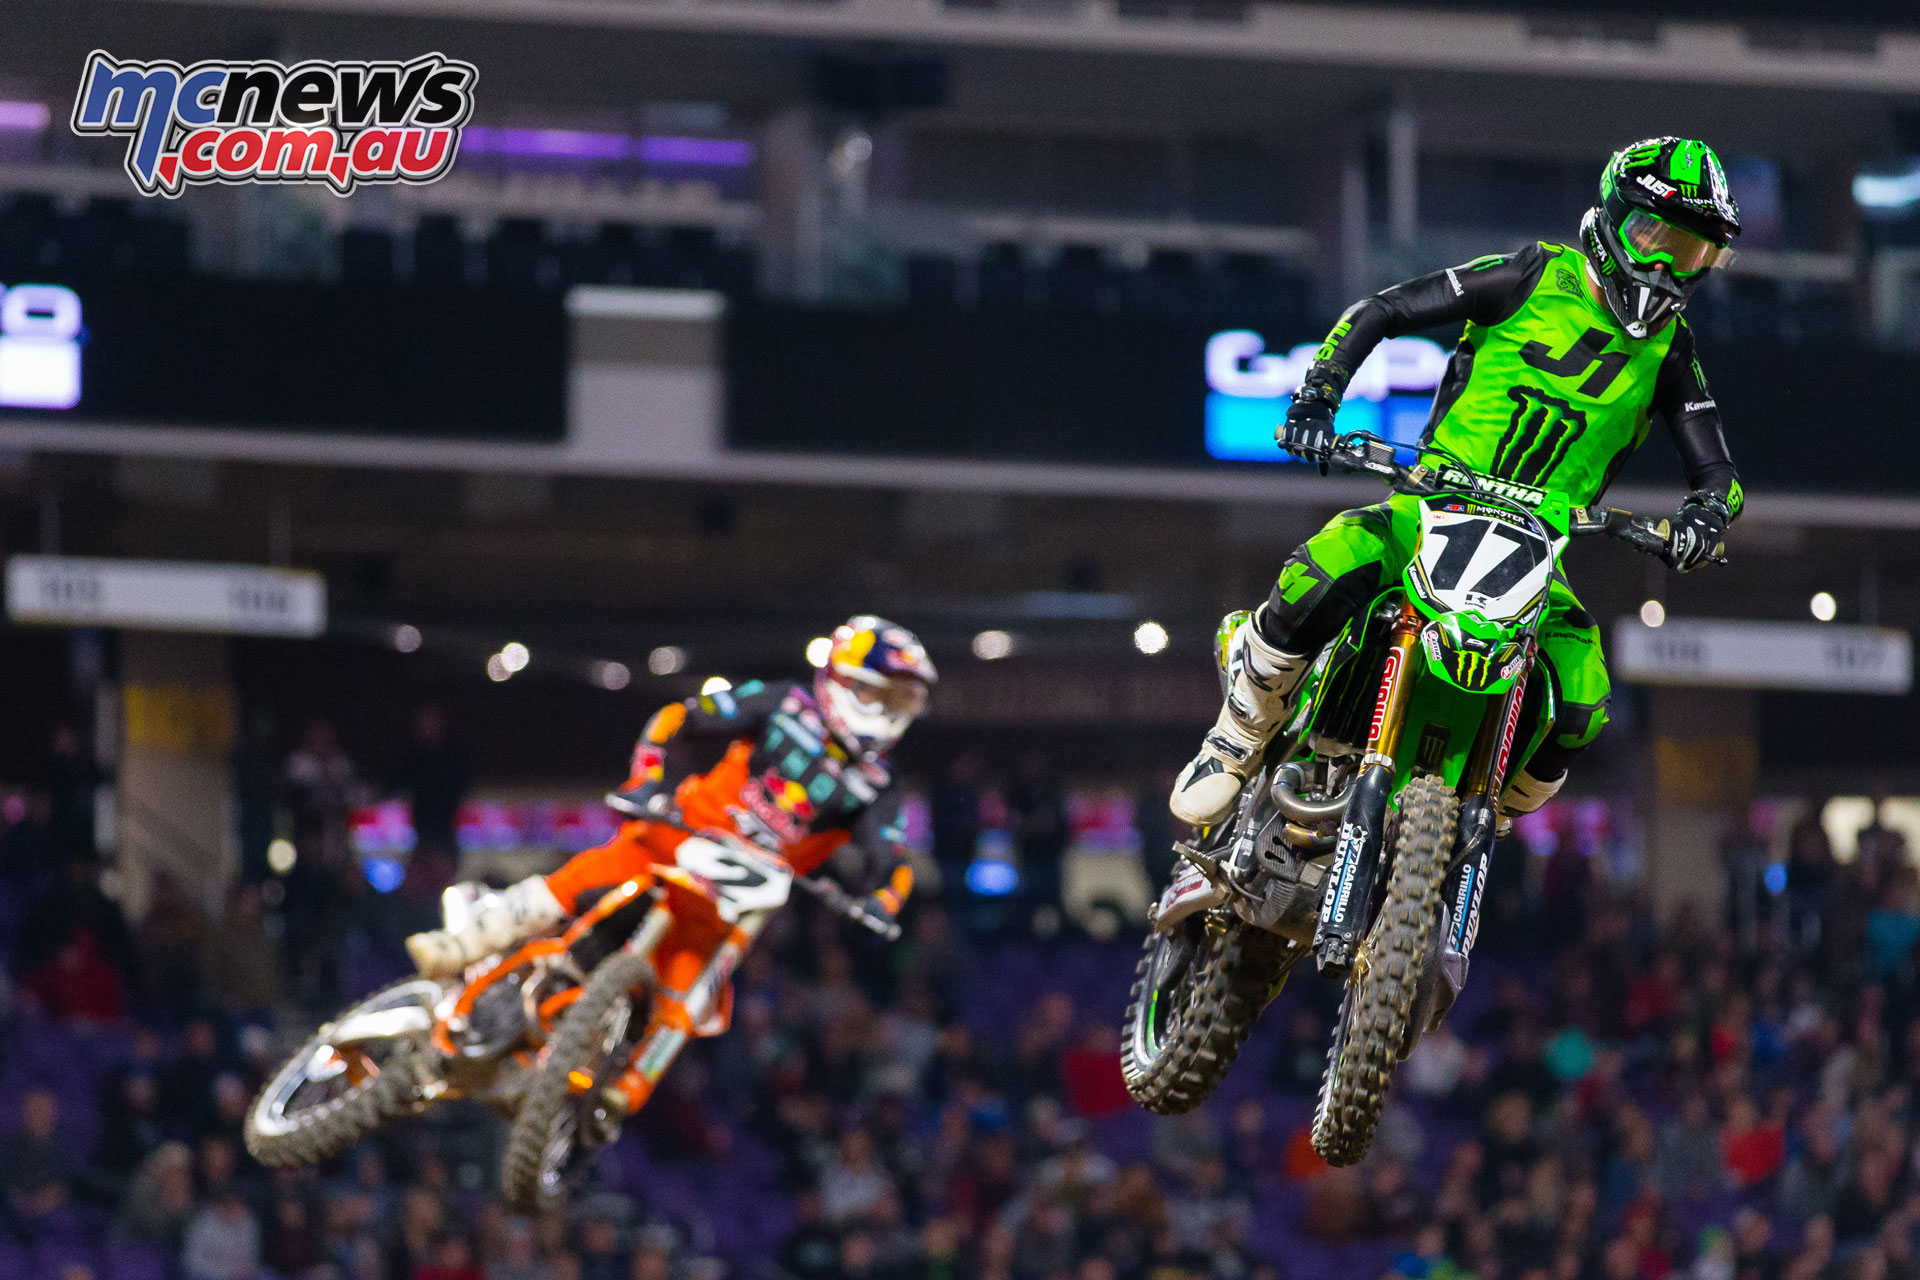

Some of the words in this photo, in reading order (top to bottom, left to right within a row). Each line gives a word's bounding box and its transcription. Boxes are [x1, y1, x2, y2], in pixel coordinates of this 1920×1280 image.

[1442, 469, 1545, 506] RENTHA
[1429, 518, 1549, 598] 17
[1322, 822, 1354, 923] DUNLOP
[1334, 864, 1357, 923] CARRILLO
[1453, 863, 1472, 923] CARRILLO
[1462, 852, 1488, 957] DUNLOP
